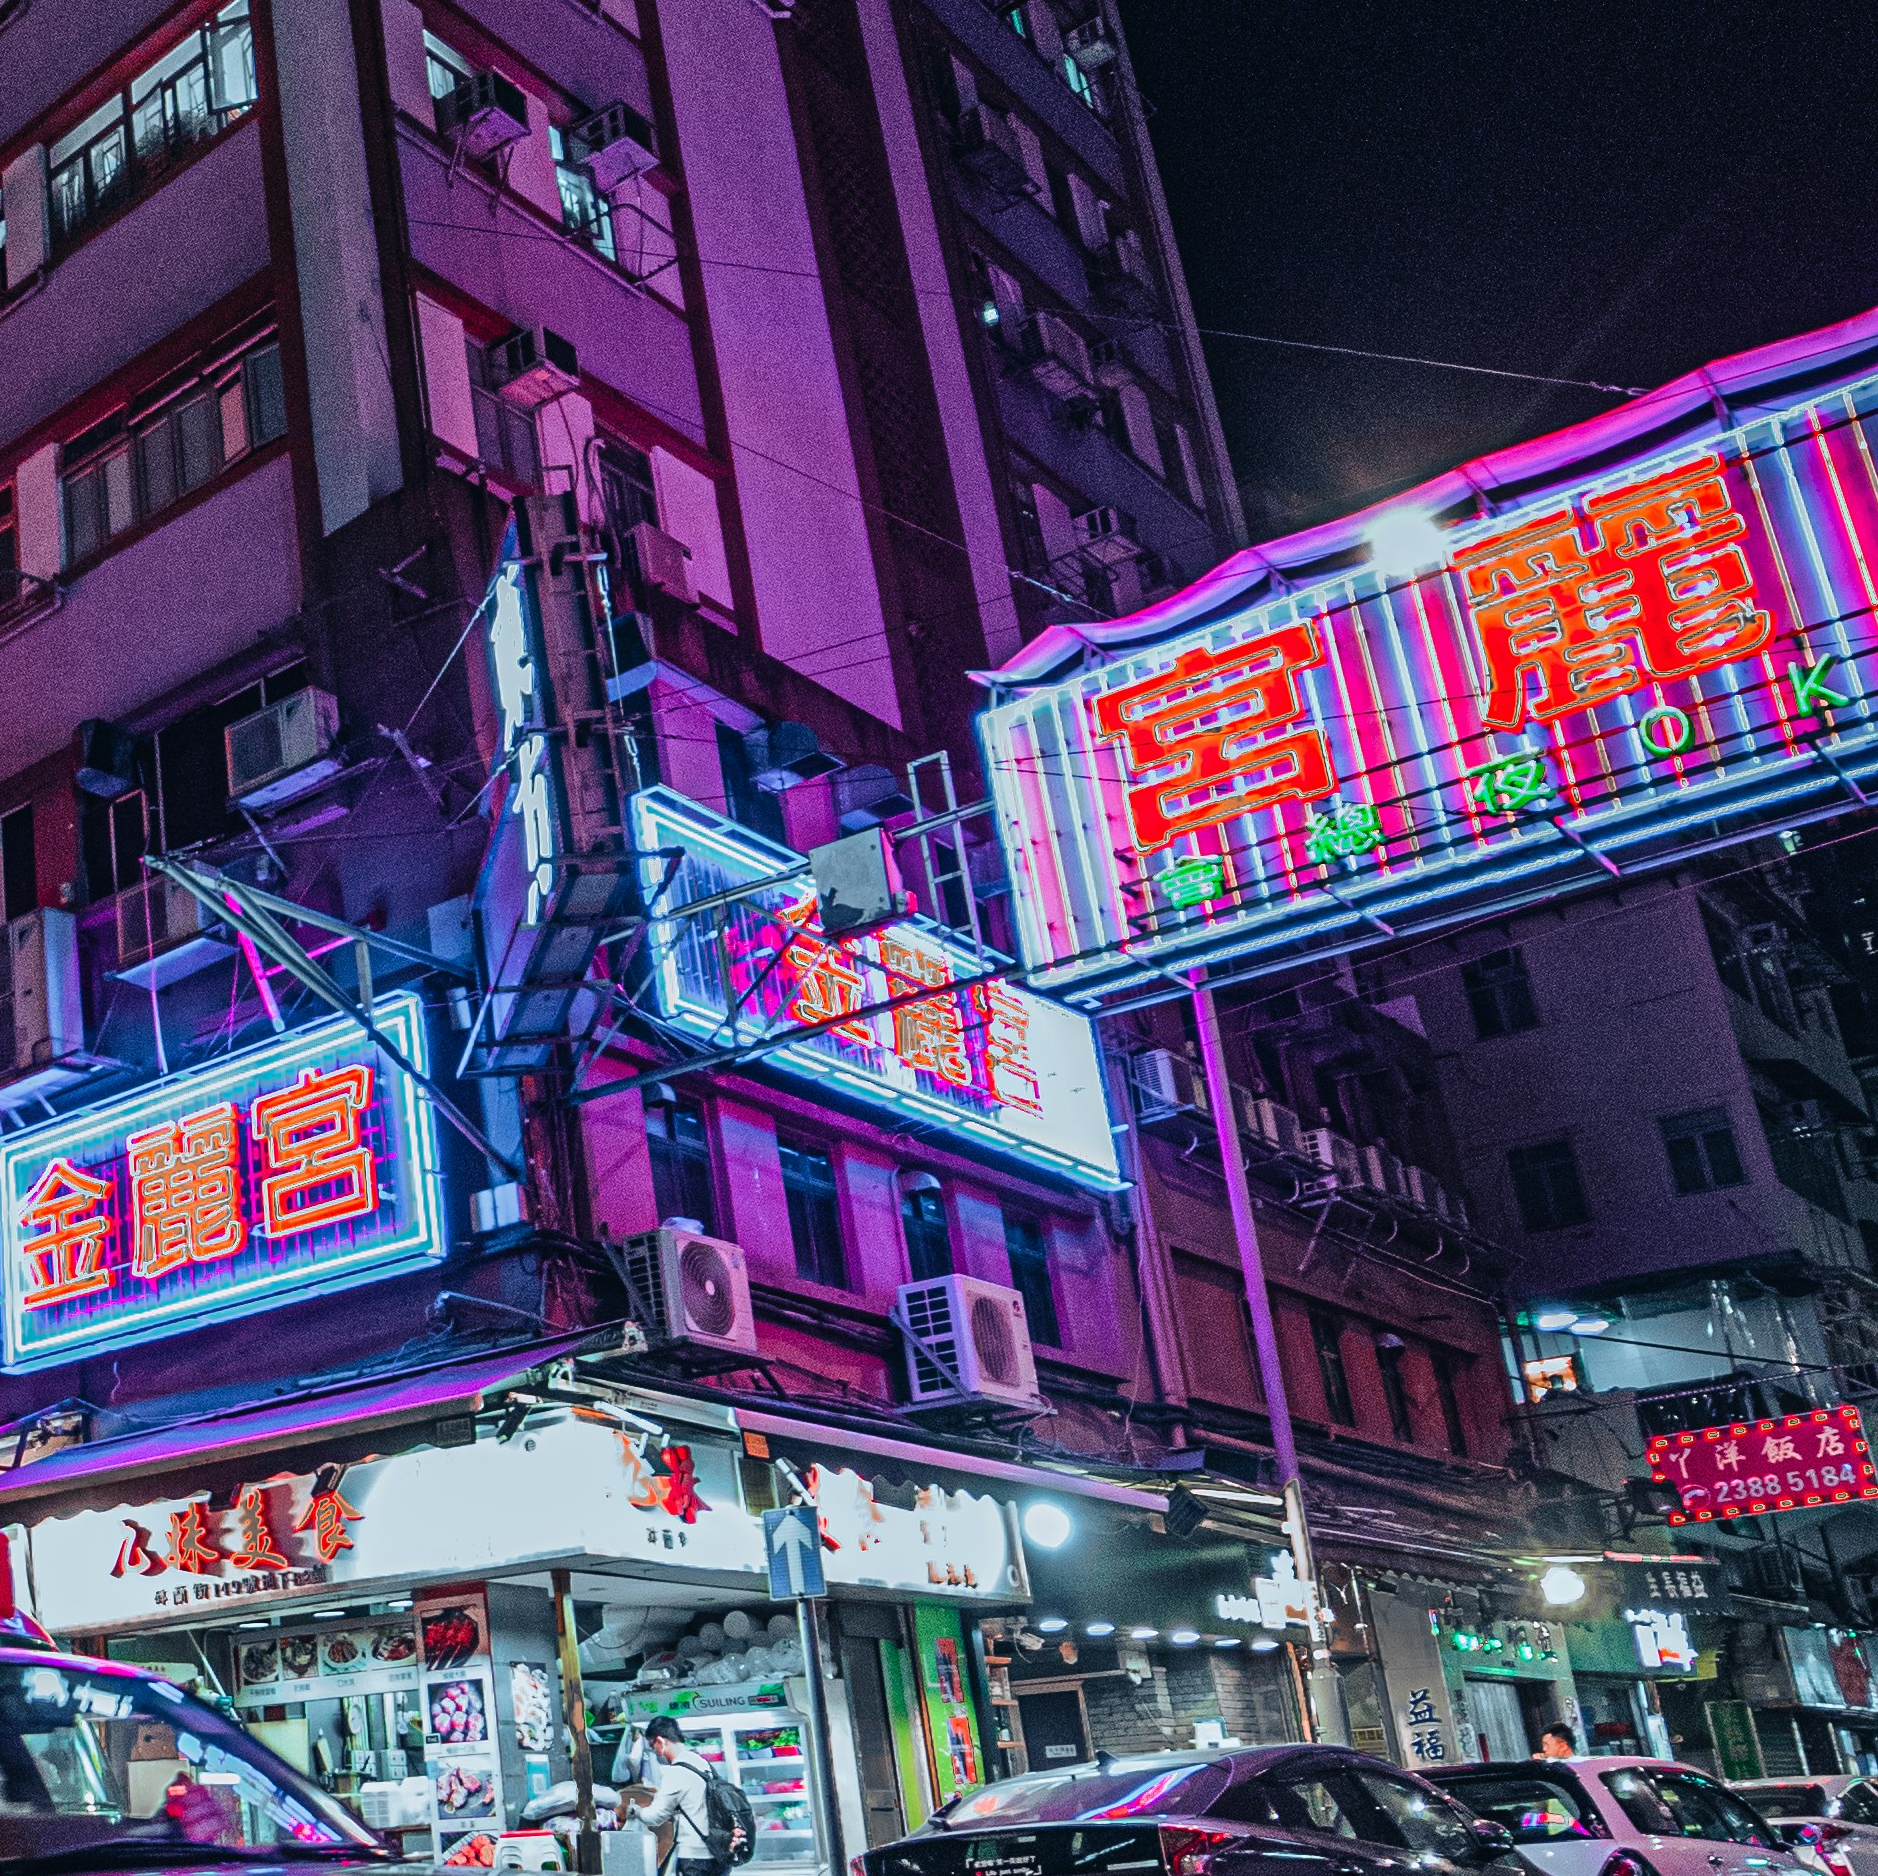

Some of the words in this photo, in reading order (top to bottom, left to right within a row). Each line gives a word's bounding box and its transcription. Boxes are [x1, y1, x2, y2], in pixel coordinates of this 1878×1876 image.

[17, 1063, 378, 1311] 金麗宮
[1713, 1473, 1782, 1503] 2388
[1786, 1462, 1857, 1493] 5184
[699, 1696, 746, 1709] SUILING
[1408, 1688, 1447, 1761] 益福
